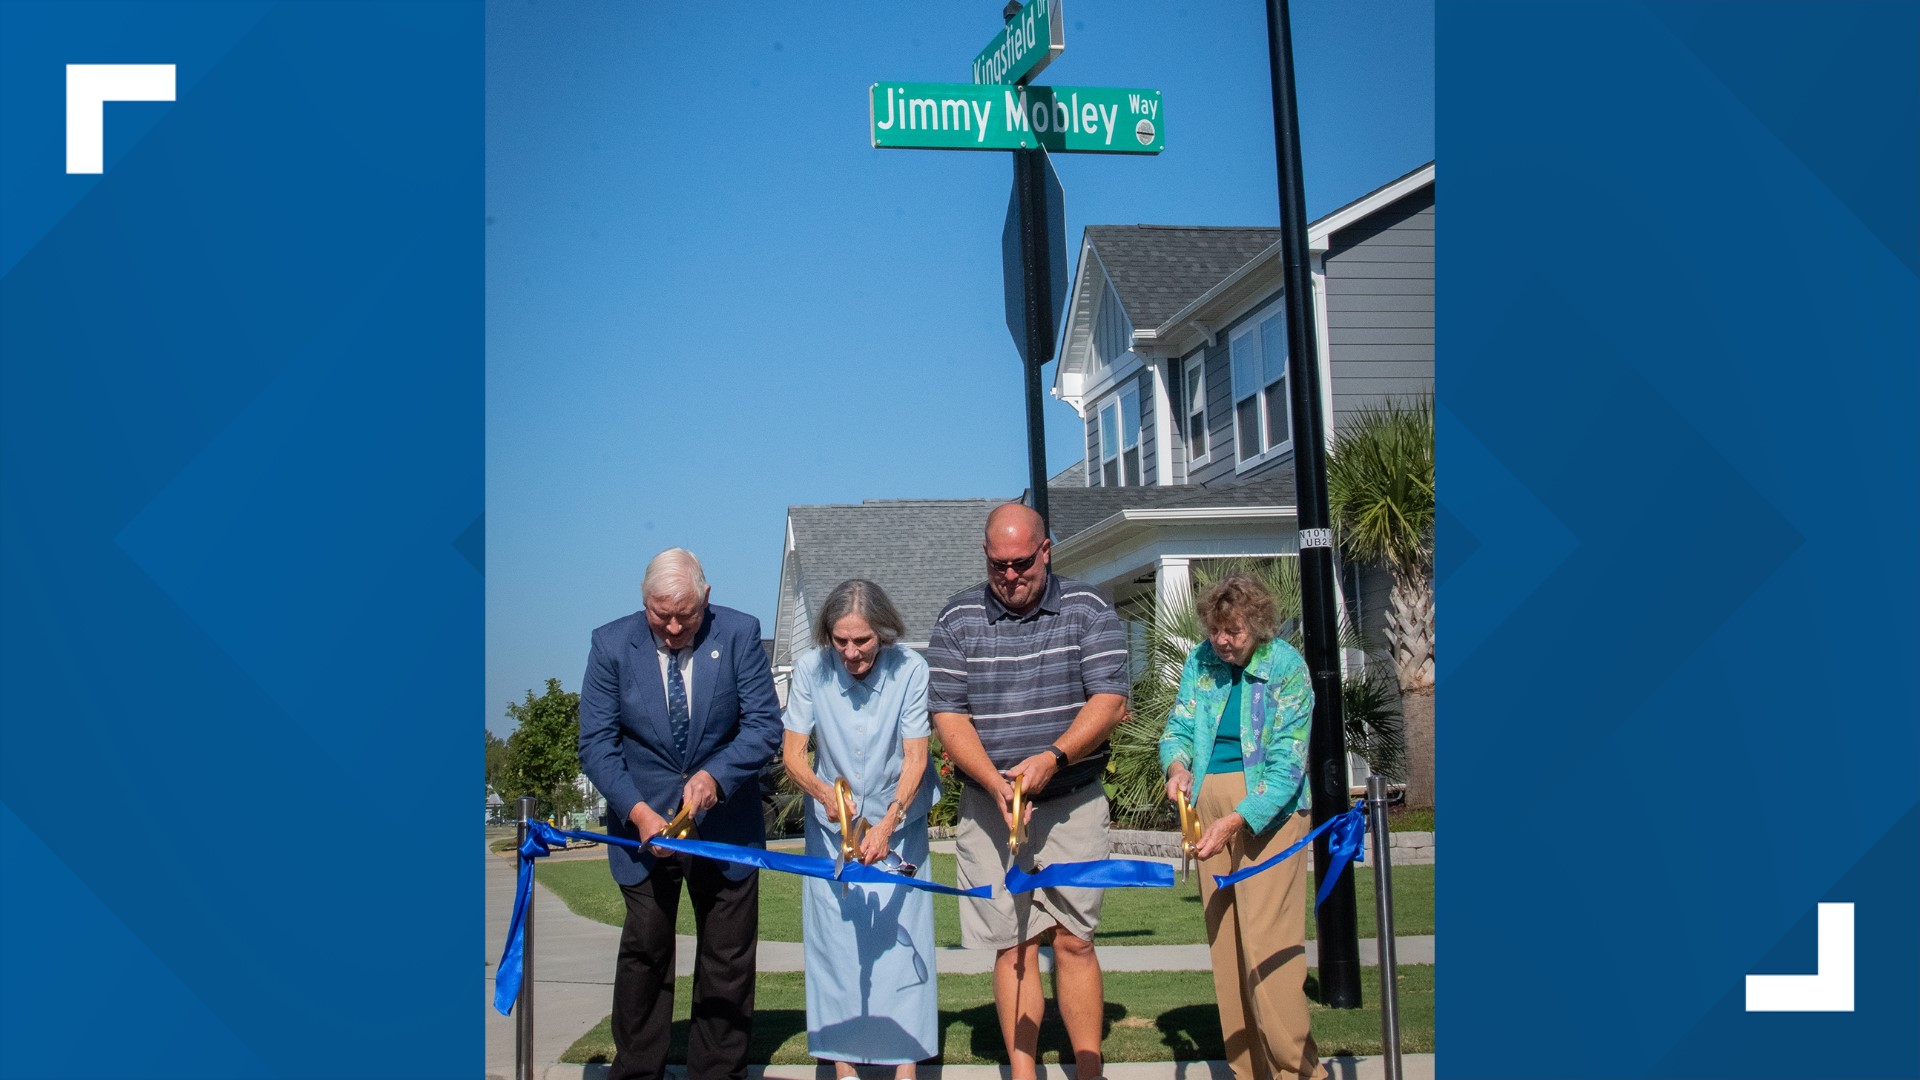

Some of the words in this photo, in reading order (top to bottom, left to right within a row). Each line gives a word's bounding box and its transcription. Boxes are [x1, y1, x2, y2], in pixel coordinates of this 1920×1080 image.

[973, 3, 1036, 85] Kingsfield
[877, 87, 992, 143] Jimmy
[1004, 90, 1119, 145] Mobley
[1128, 93, 1158, 120] Way
